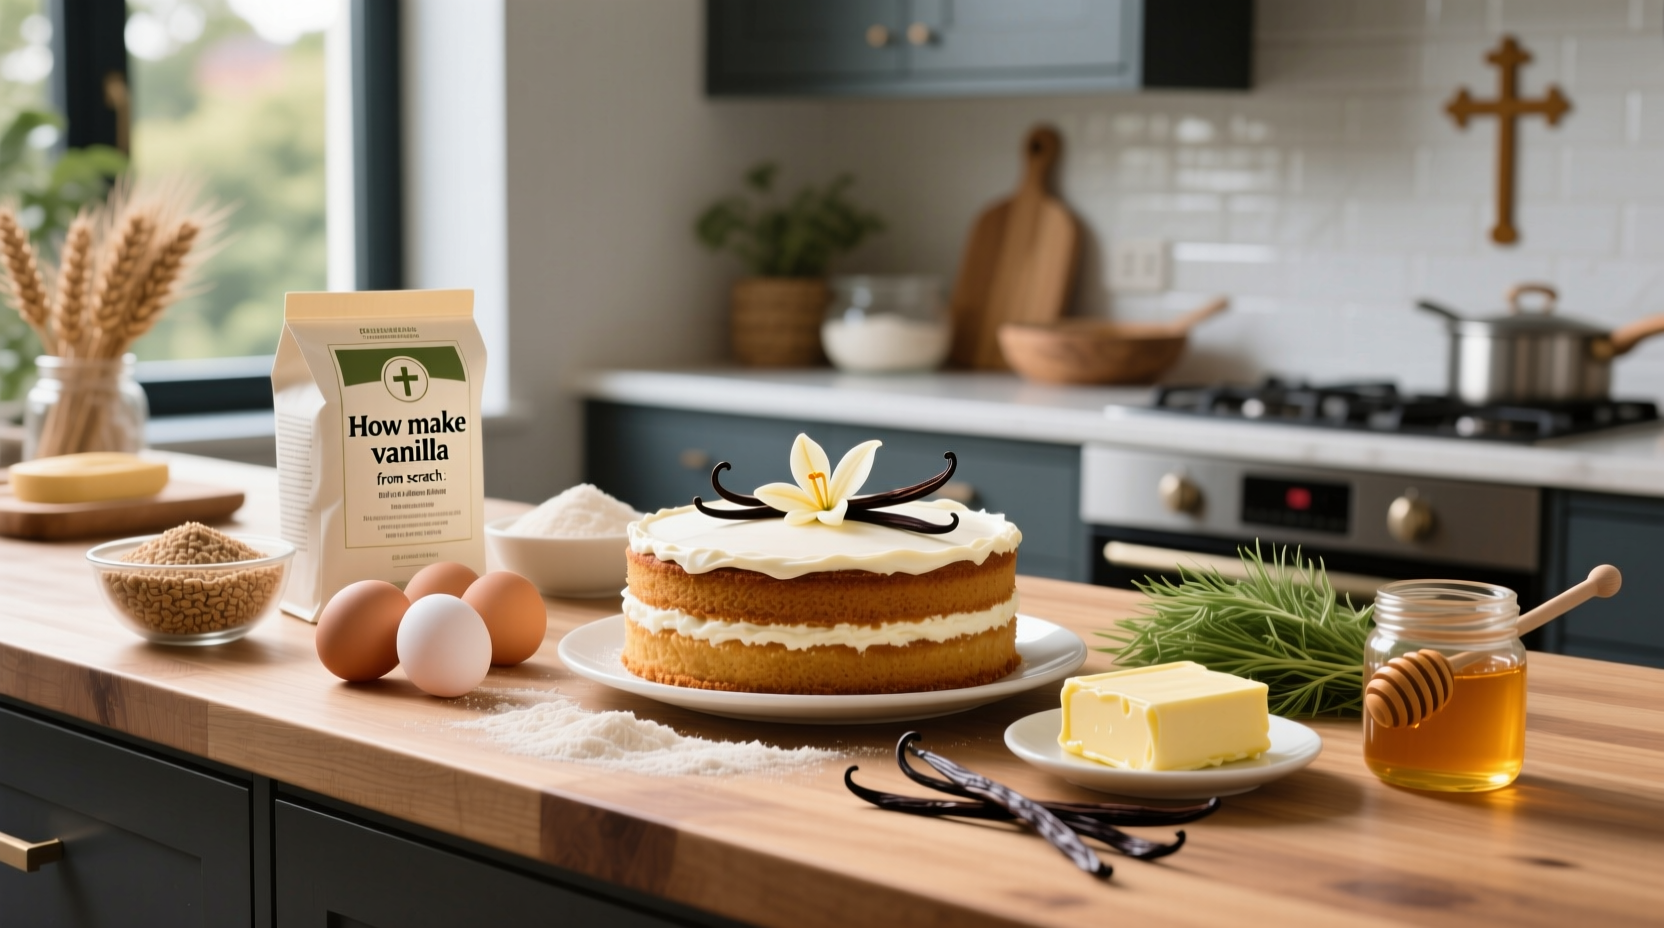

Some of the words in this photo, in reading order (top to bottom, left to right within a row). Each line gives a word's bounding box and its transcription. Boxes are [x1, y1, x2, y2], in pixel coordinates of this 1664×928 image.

[348, 415, 402, 437] How
[408, 410, 466, 435] make
[371, 438, 449, 464] vanilla
[377, 472, 403, 485] from
